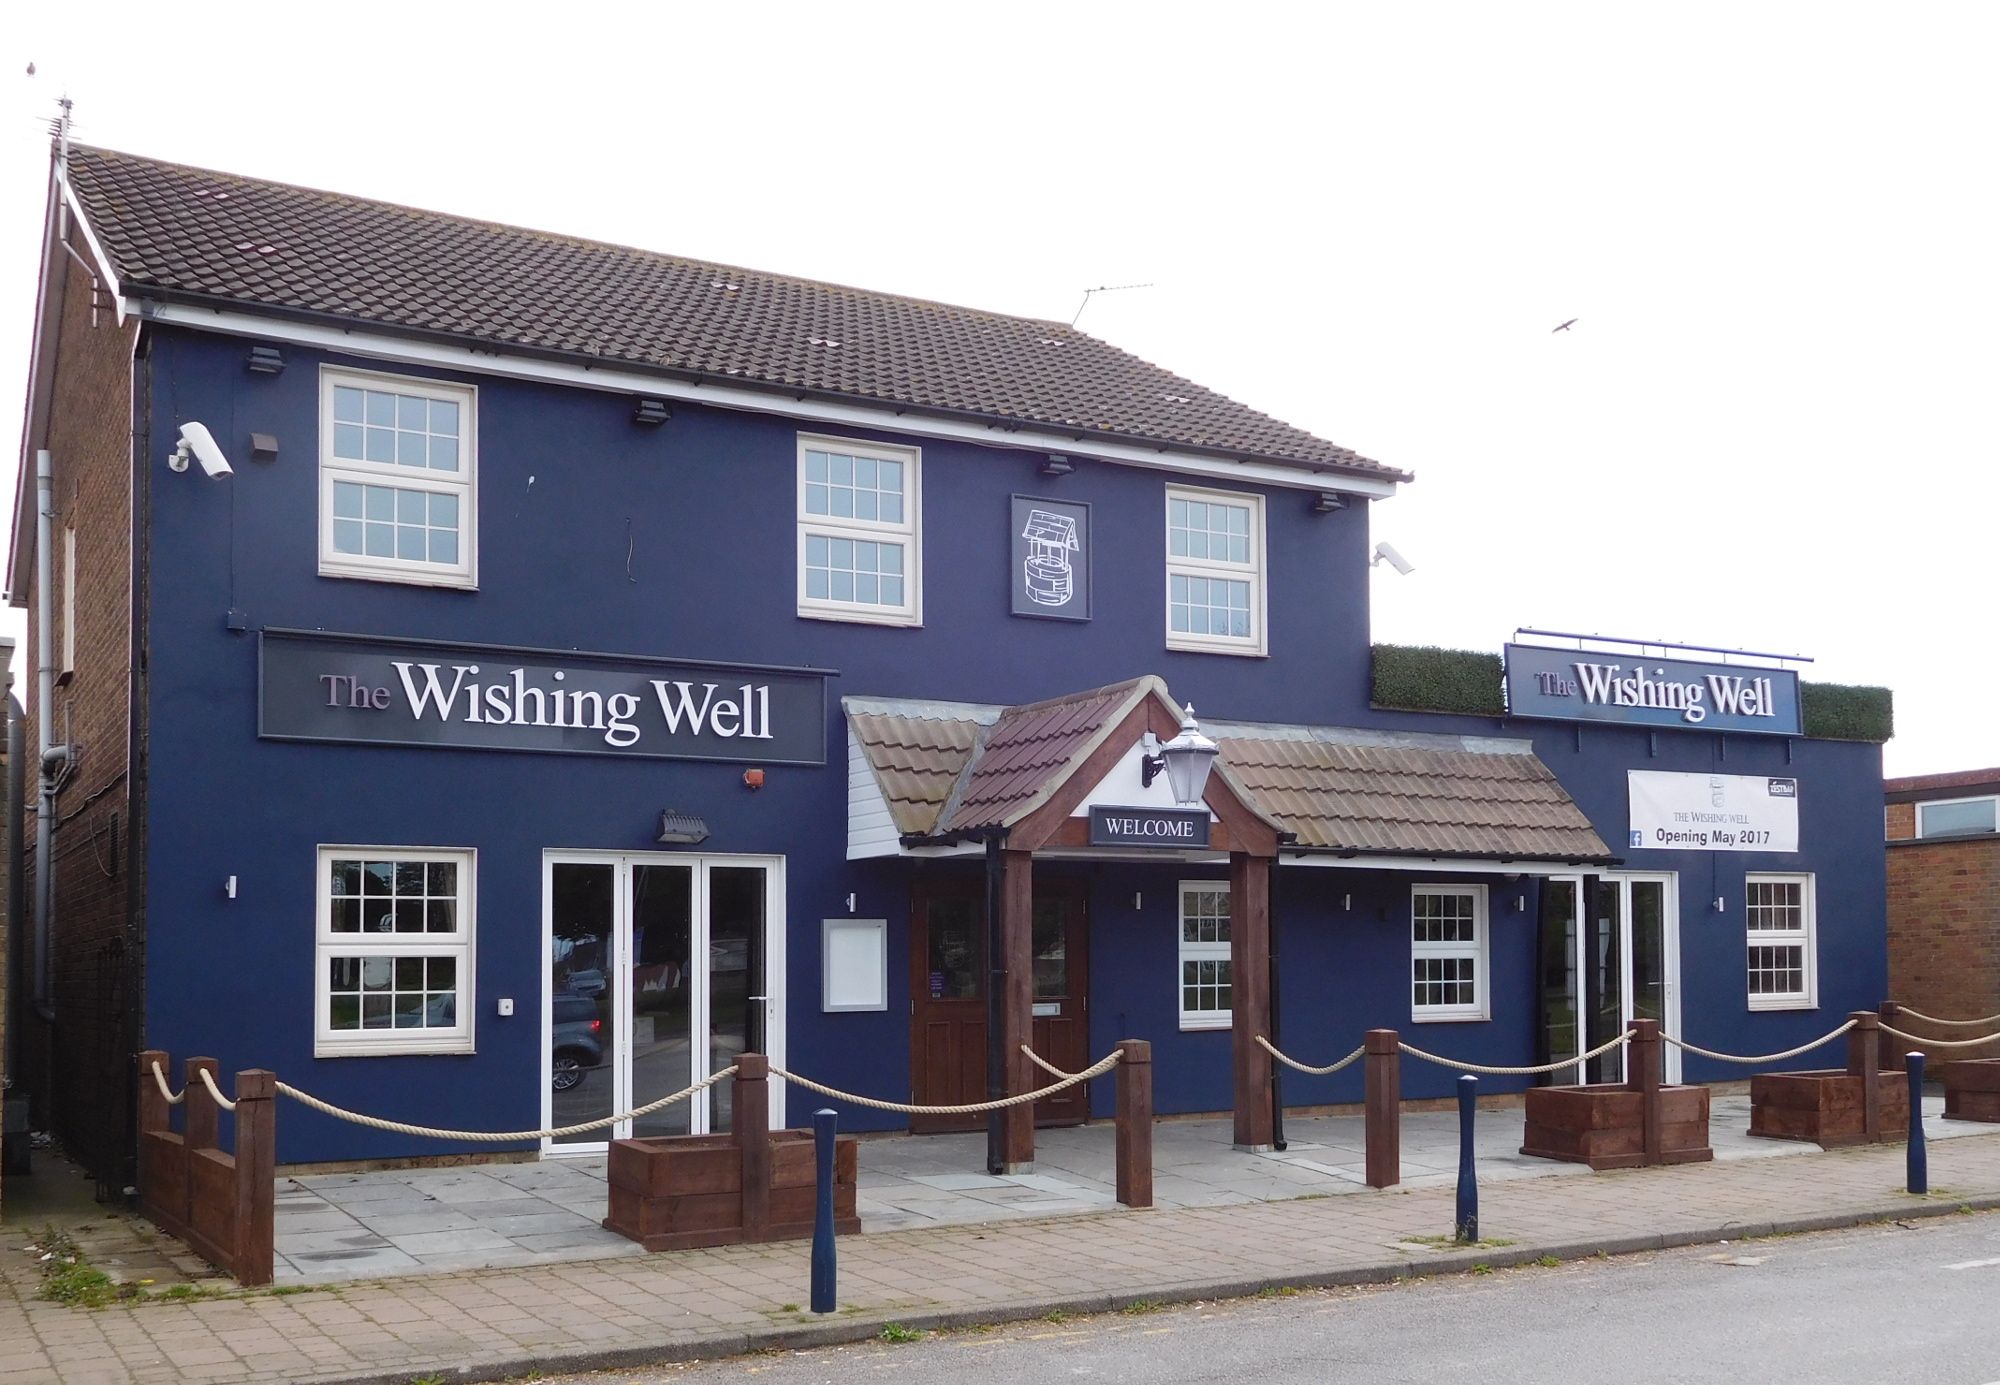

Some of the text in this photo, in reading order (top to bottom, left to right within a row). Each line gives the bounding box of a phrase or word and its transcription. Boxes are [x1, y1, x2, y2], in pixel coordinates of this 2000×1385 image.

[1538, 662, 1776, 723] The Wishing Well
[319, 661, 775, 748] The Wishing Well
[1105, 817, 1194, 837] WELCOME
[1673, 811, 1750, 825] THE WISHING WELL
[1656, 827, 1771, 847] Opening May 2017
